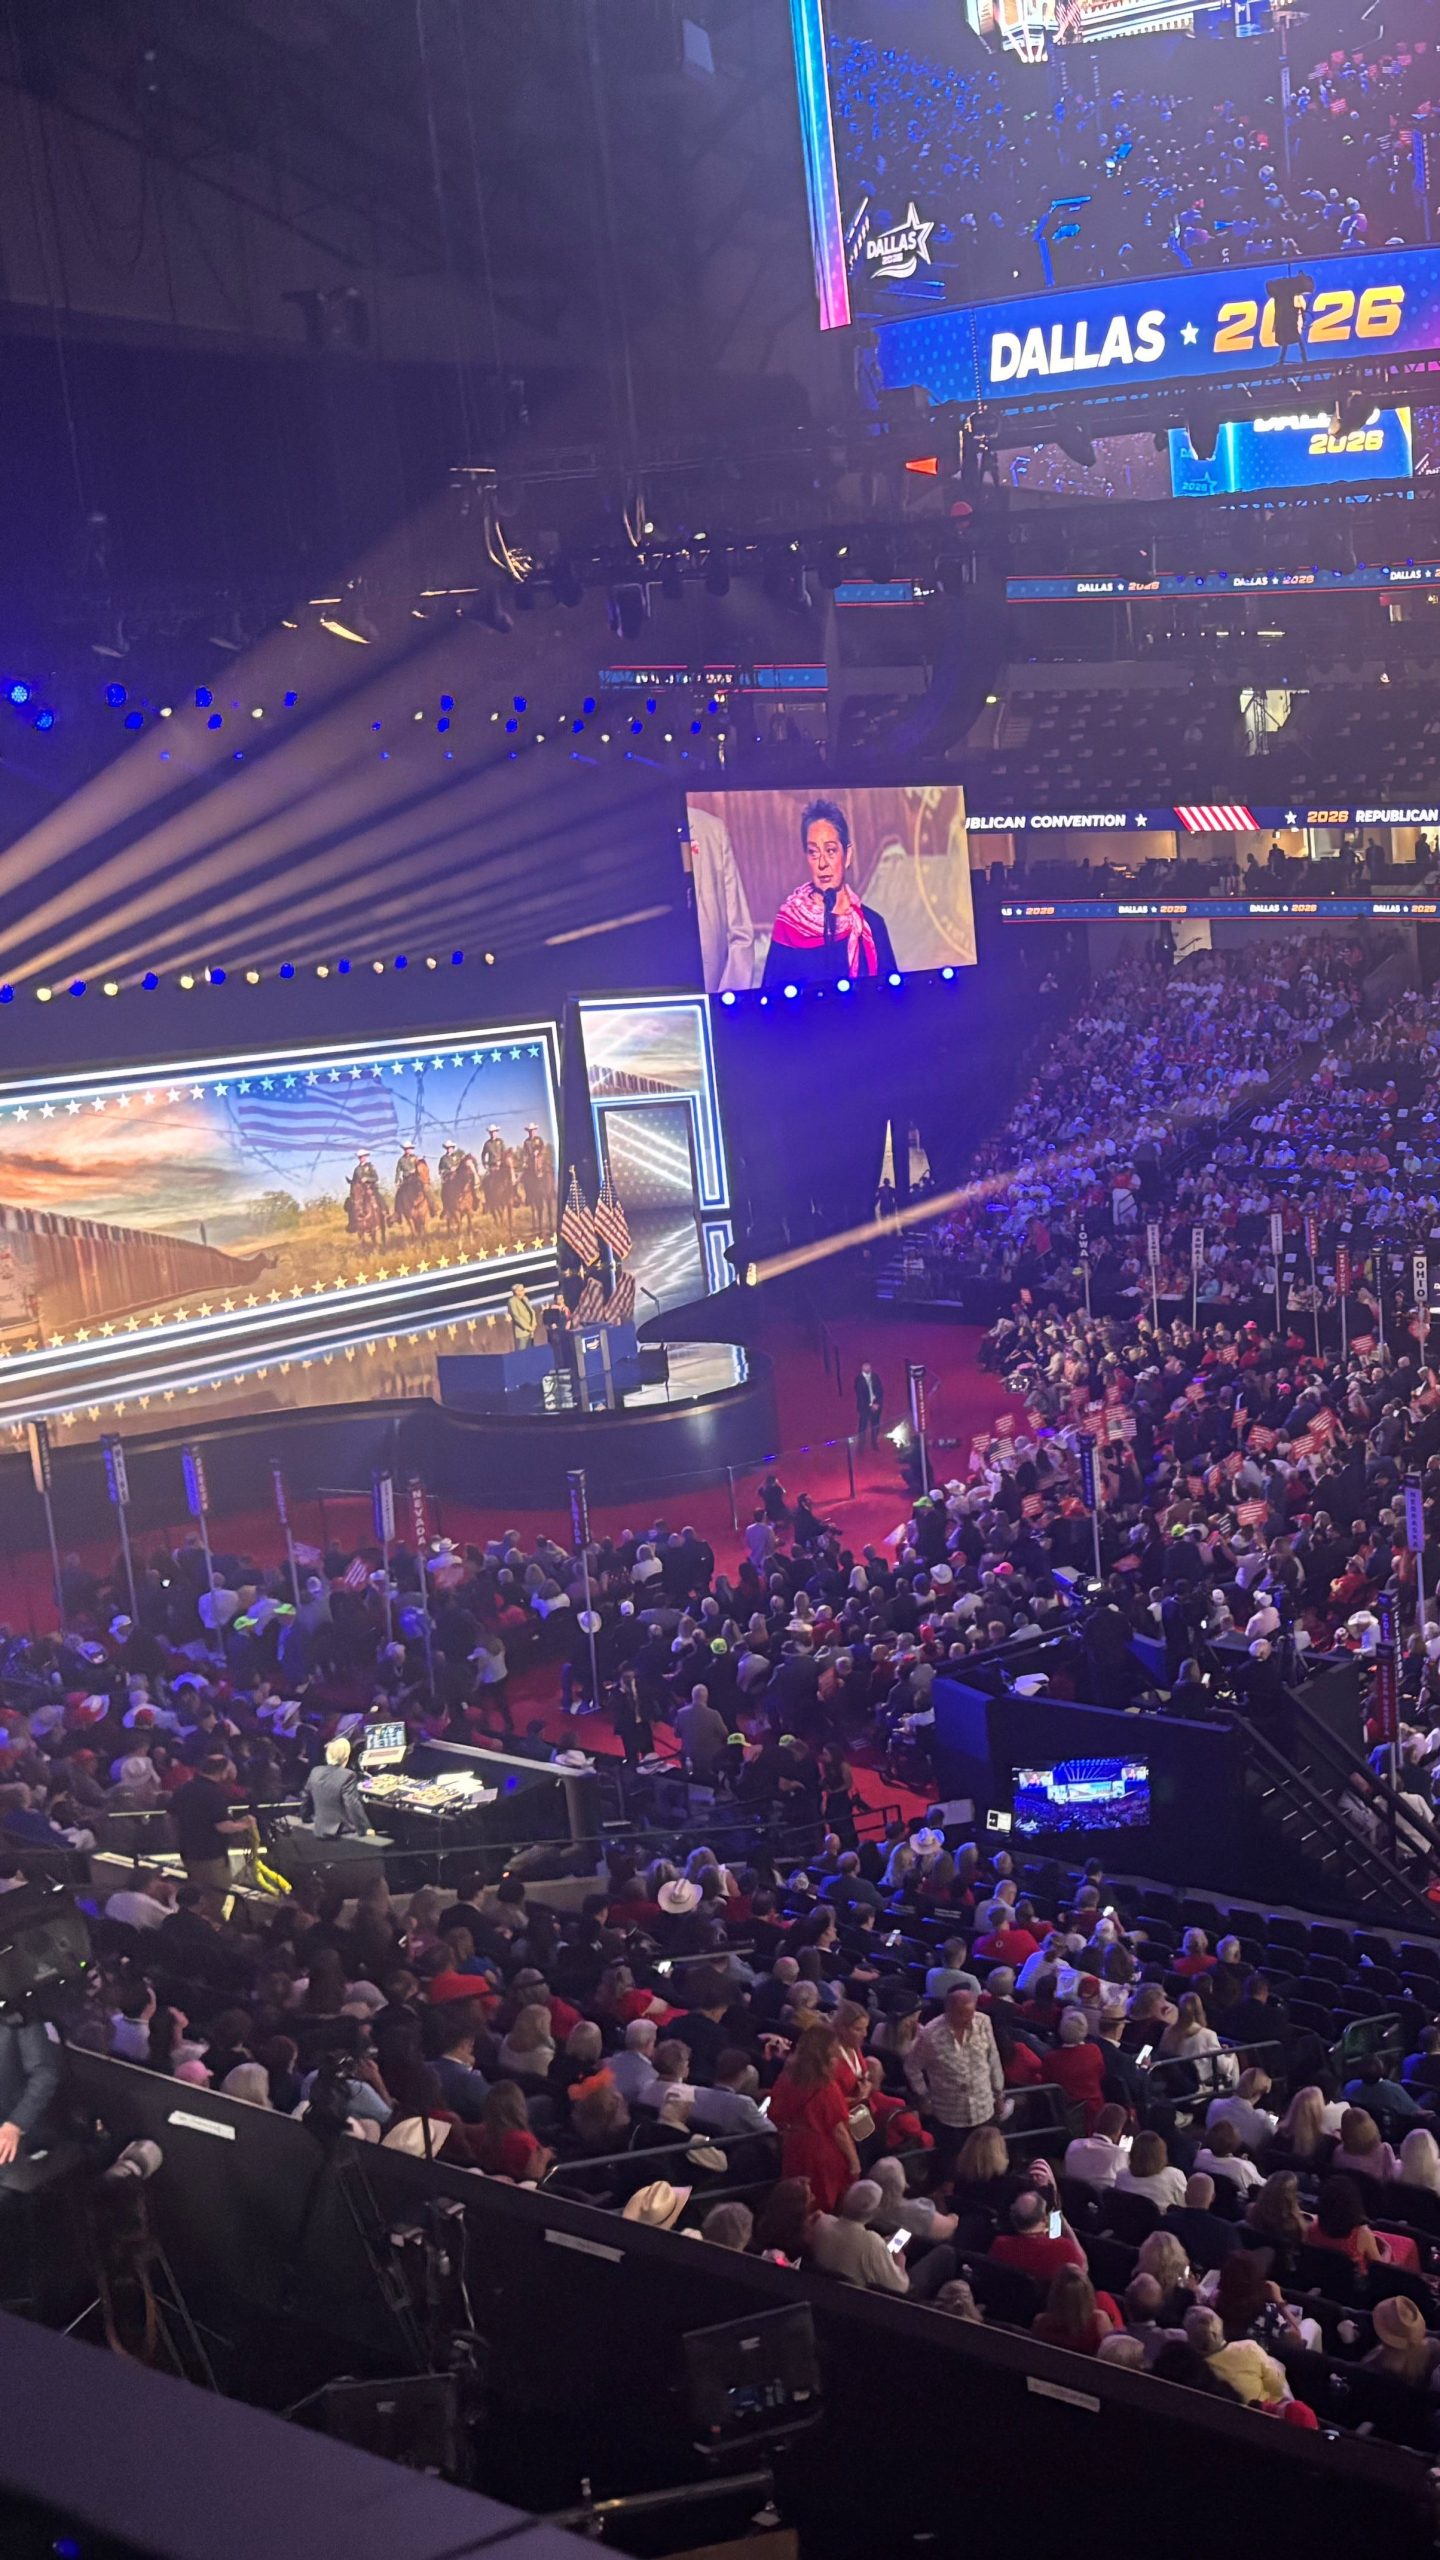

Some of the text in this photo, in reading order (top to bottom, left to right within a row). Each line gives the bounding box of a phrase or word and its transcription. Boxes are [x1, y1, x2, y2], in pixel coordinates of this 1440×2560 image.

[866, 231, 917, 259] DALLAS
[990, 309, 1167, 383] DALLAS
[1389, 570, 1422, 580] DALLAS
[1077, 583, 1113, 593] DALLAS
[1030, 814, 1126, 829] CONVENTION
[1306, 809, 1439, 824] 2026 REPUBLICAN
[1118, 905, 1148, 914] DALLAS
[1250, 904, 1280, 913] DALLAS
[1373, 904, 1401, 913] DALLAS
[1078, 1223, 1089, 1257] IOWA
[1194, 1231, 1203, 1267] HAWAII
[1416, 1261, 1425, 1297] OHIO
[412, 1489, 427, 1545] NEVADA
[1409, 1491, 1419, 1548] NEBRASKA
